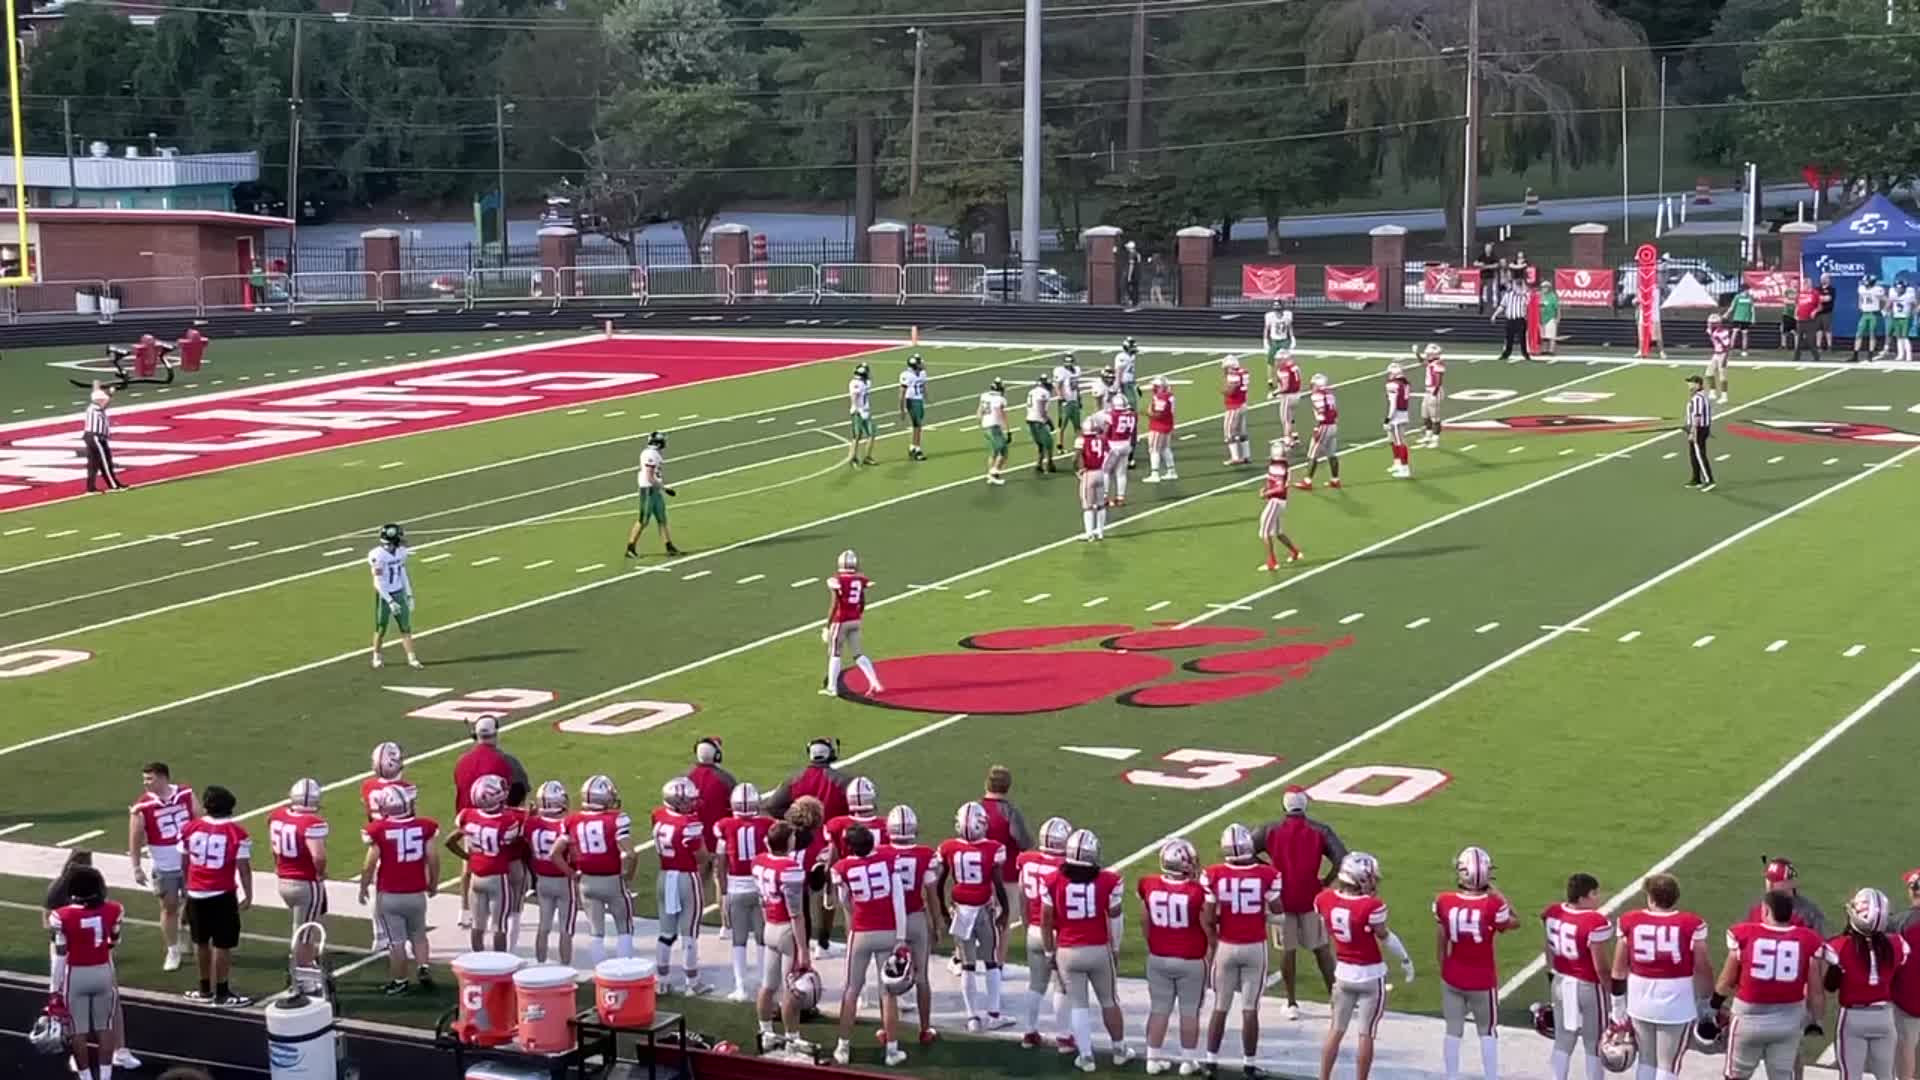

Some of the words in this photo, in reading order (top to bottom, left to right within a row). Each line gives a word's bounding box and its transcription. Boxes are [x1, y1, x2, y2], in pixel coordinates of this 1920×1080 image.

[1555, 289, 1610, 299] VANNOY
[1118, 416, 1136, 433] 64
[1091, 439, 1102, 457] 4
[848, 580, 861, 603] 3
[190, 832, 226, 869] 99
[385, 826, 424, 863] 75
[576, 820, 608, 854] 18
[738, 826, 756, 861] 11
[846, 860, 891, 902] 33
[953, 850, 983, 884] 16
[1065, 883, 1096, 919] 51
[1148, 893, 1189, 928] 60
[1218, 877, 1262, 914] 42
[80, 916, 103, 948] 7
[1329, 907, 1352, 942] 9
[1448, 907, 1482, 943] 14
[1546, 917, 1580, 960] 56
[1632, 924, 1681, 964] 54
[1750, 937, 1800, 982] 58
[463, 985, 482, 1010] G
[603, 990, 618, 1006] G
